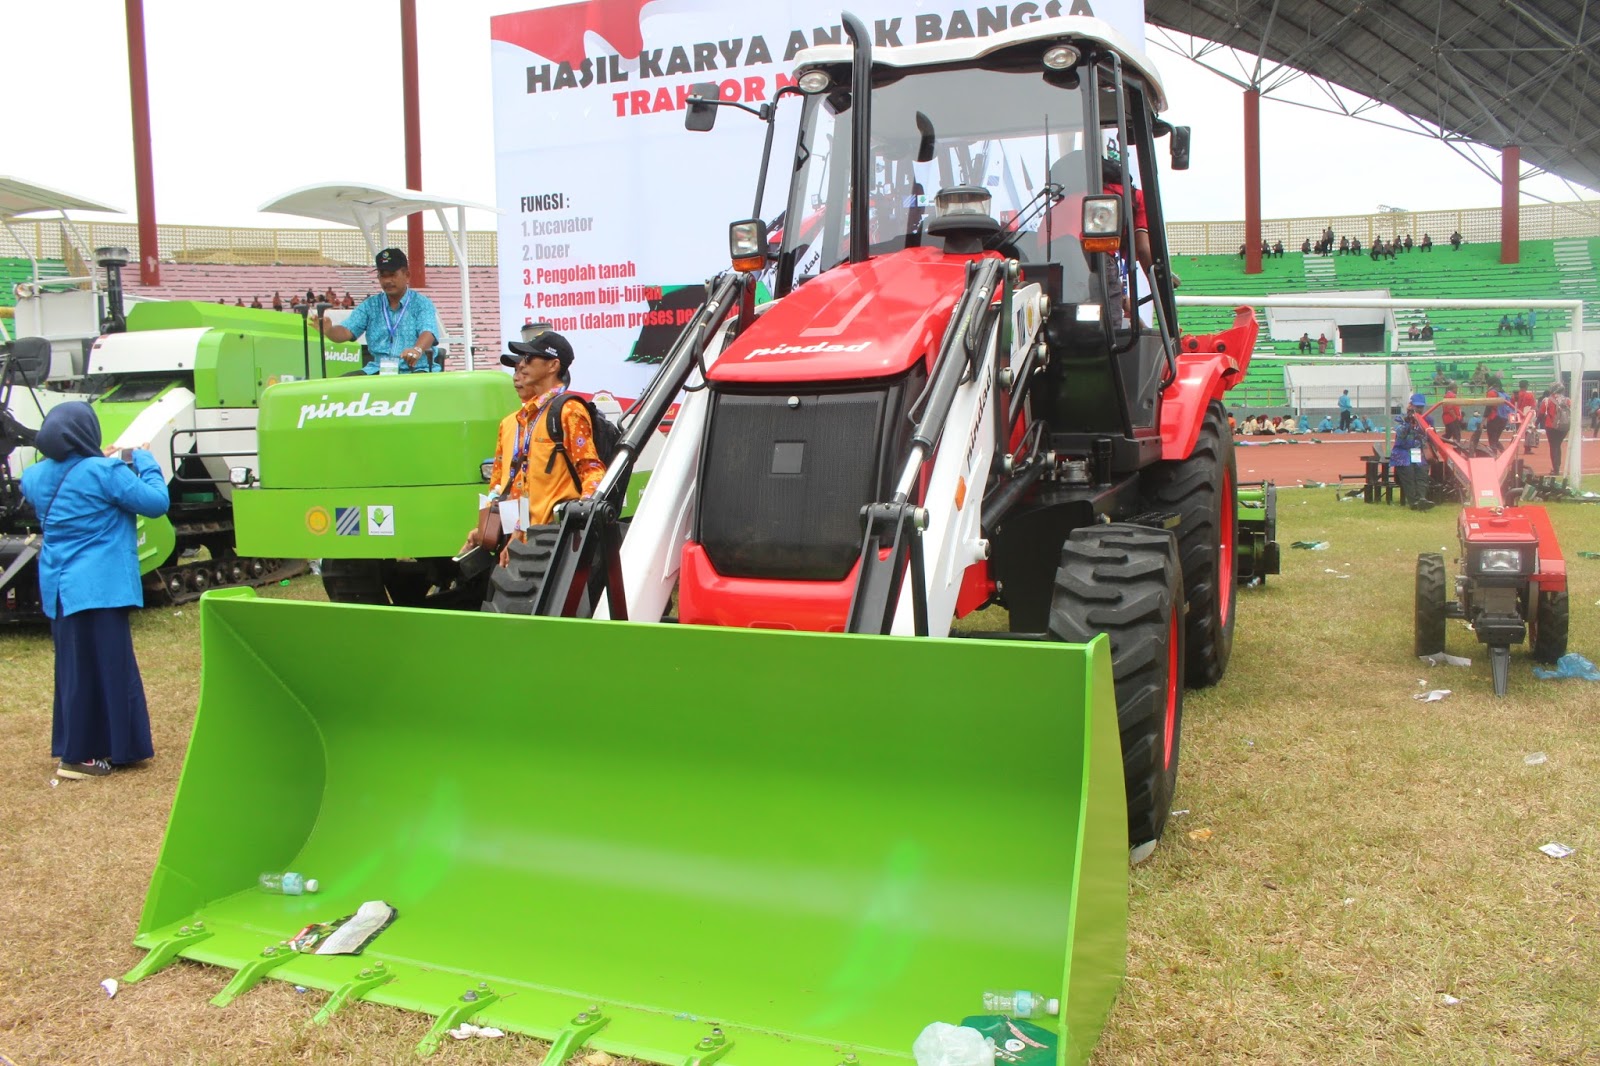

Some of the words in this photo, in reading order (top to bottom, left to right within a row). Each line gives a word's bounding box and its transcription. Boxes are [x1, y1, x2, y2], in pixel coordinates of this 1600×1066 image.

[526, 55, 628, 94] HASIL
[640, 35, 773, 79] KARYA
[783, 17, 902, 61] ANK
[612, 76, 766, 117] TRAKOR
[520, 193, 563, 213] FUNGSI
[521, 221, 530, 237] 1.
[533, 216, 593, 236] Excavator
[522, 244, 533, 261] 2.
[535, 244, 570, 260] Dozer
[523, 268, 534, 285] 3.
[537, 264, 596, 284] Pengolah
[598, 261, 636, 279] tanah
[524, 292, 535, 309] 4.
[537, 288, 596, 308] Penanam
[598, 285, 662, 305] biji-bijian
[580, 312, 625, 330] (dalam
[628, 309, 674, 329] proses
[744, 342, 872, 360] pindad
[297, 392, 418, 428] pindad
[967, 364, 992, 473] pindad
